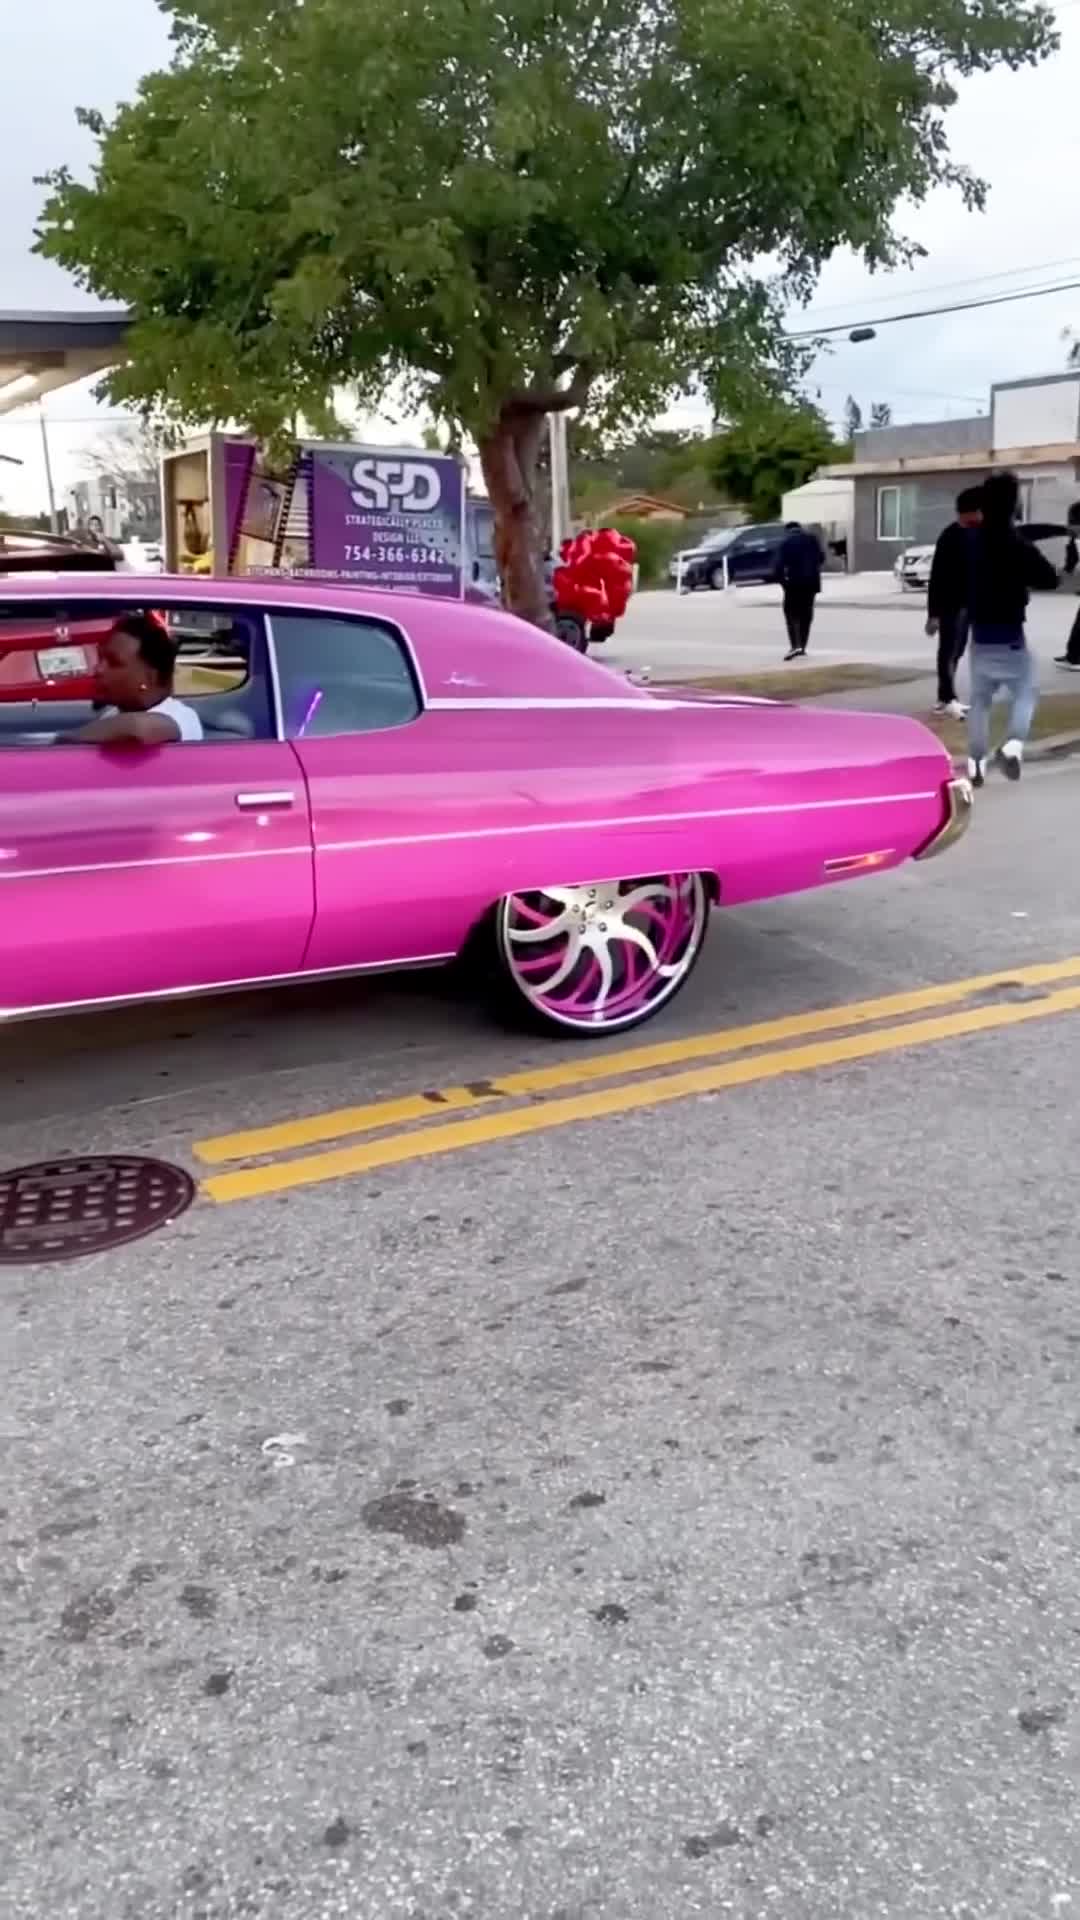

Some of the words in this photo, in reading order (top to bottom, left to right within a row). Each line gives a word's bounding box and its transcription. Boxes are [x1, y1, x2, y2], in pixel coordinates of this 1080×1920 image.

[351, 459, 442, 512] SPD
[372, 531, 404, 543] DESIGN
[343, 545, 445, 564] 754-366-6342
